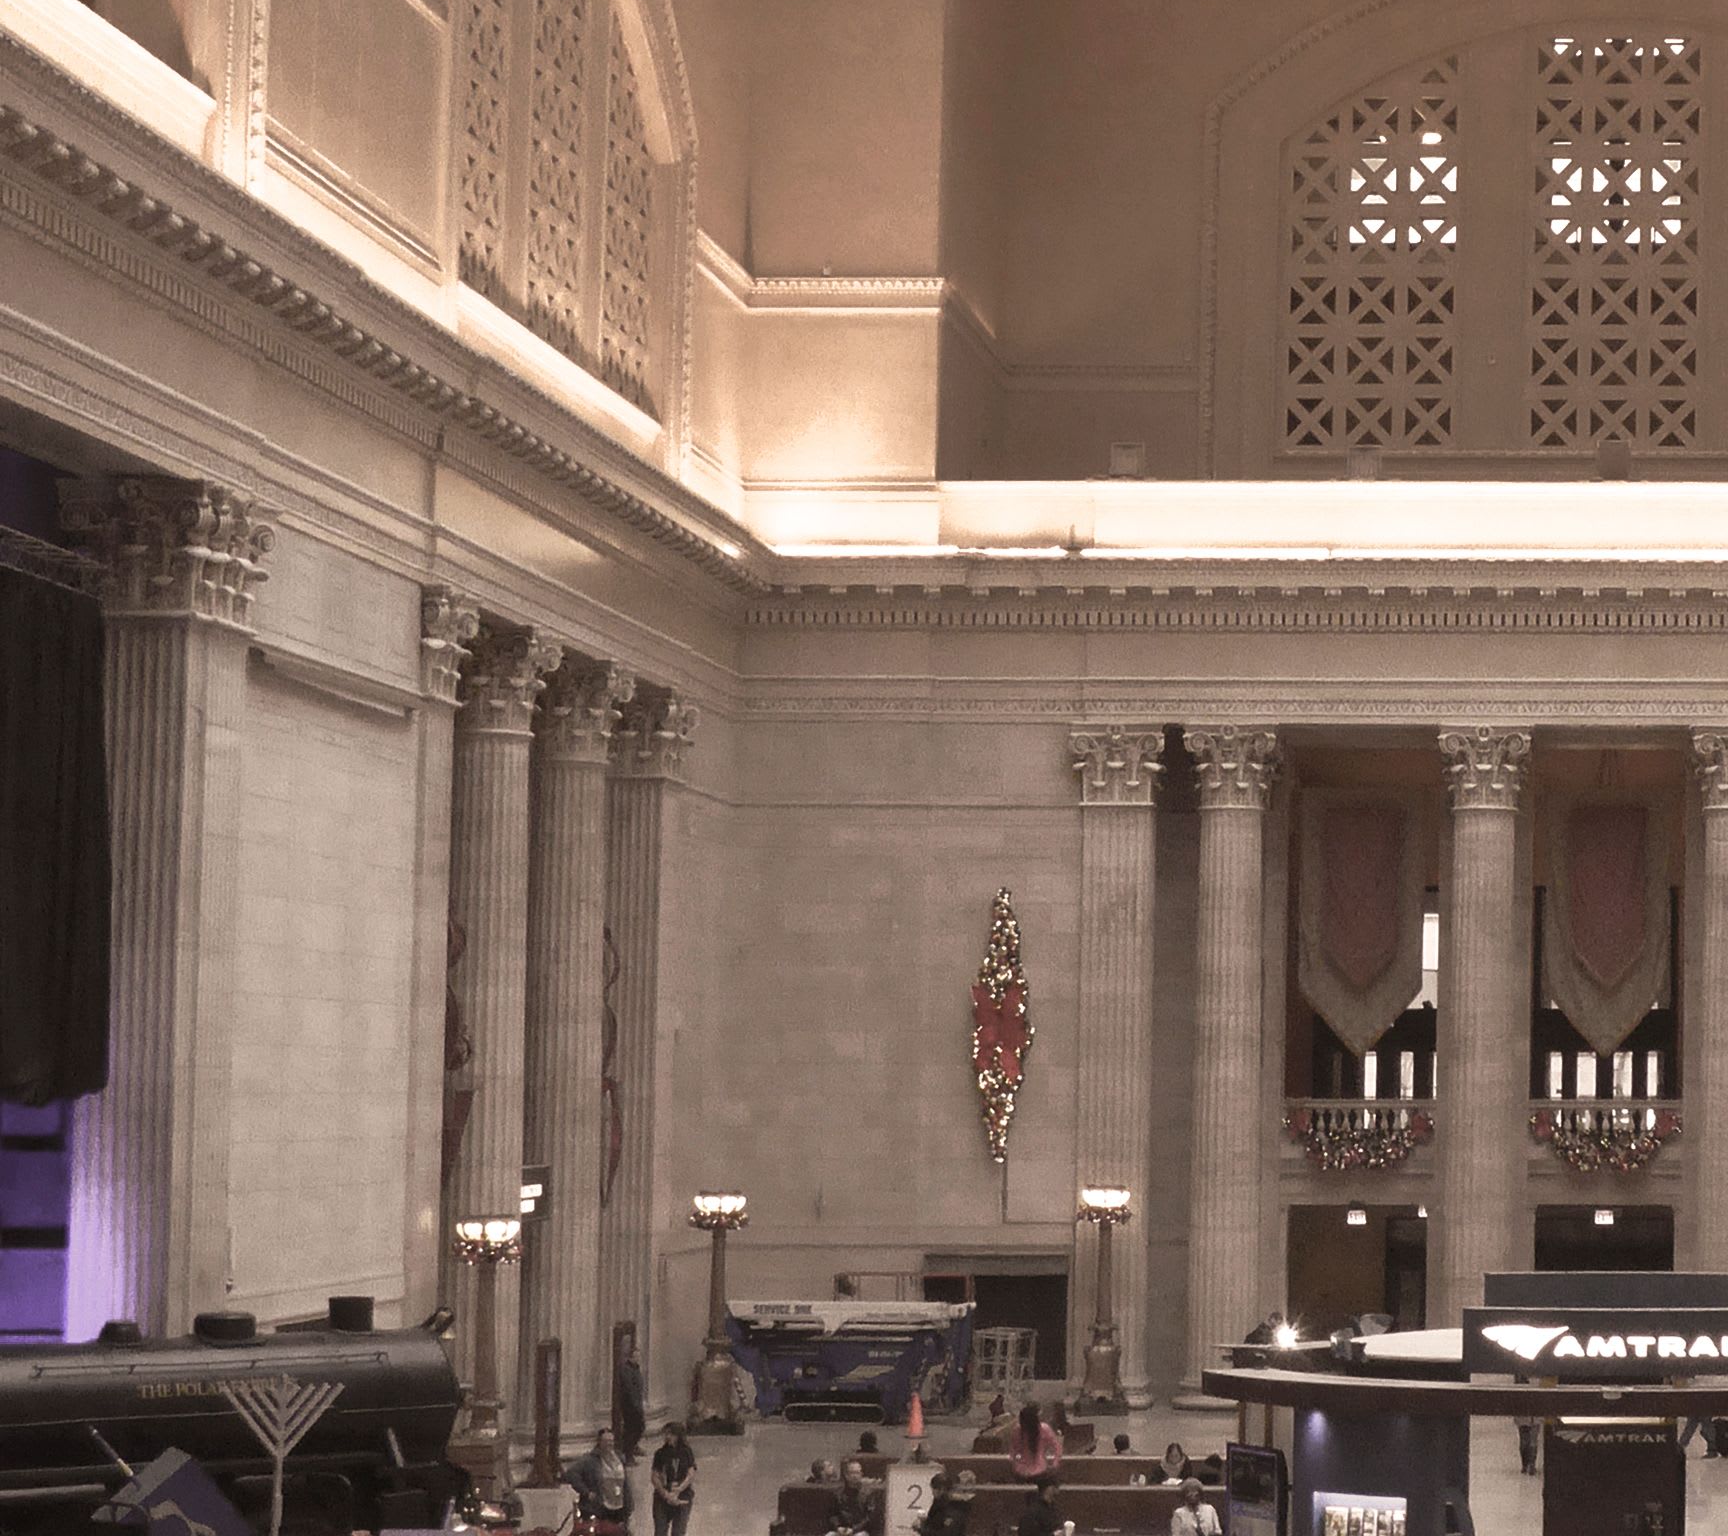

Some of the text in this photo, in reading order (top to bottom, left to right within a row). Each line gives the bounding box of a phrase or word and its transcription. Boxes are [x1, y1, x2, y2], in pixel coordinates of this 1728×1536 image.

[139, 1383, 173, 1399] THE
[1583, 1432, 1668, 1444] AMTRAK
[906, 1484, 923, 1510] 2
